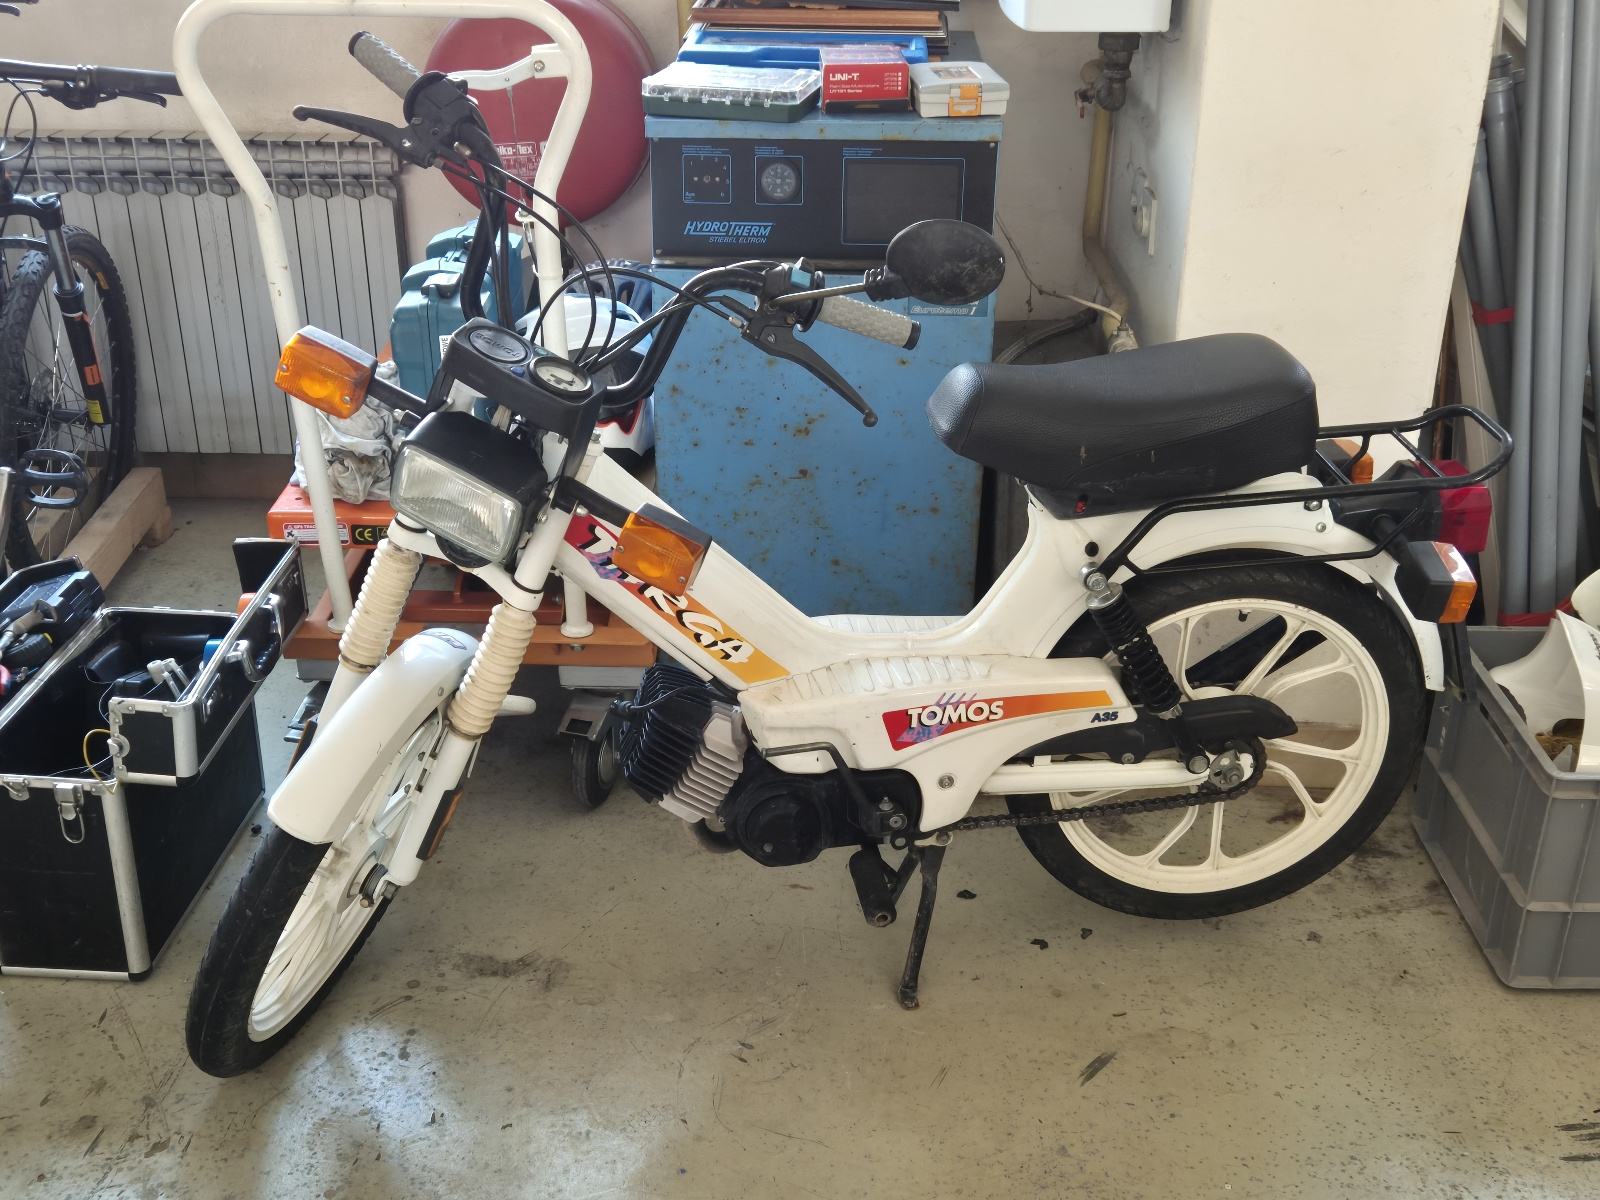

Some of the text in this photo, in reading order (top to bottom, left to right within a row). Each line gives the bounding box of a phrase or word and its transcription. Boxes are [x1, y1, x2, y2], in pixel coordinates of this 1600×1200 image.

[829, 73, 860, 81] UNI-T
[355, 528, 373, 541] CE
[577, 523, 755, 664] TRGA
[907, 700, 1004, 729] TOMOS
[1090, 711, 1119, 724] A35
